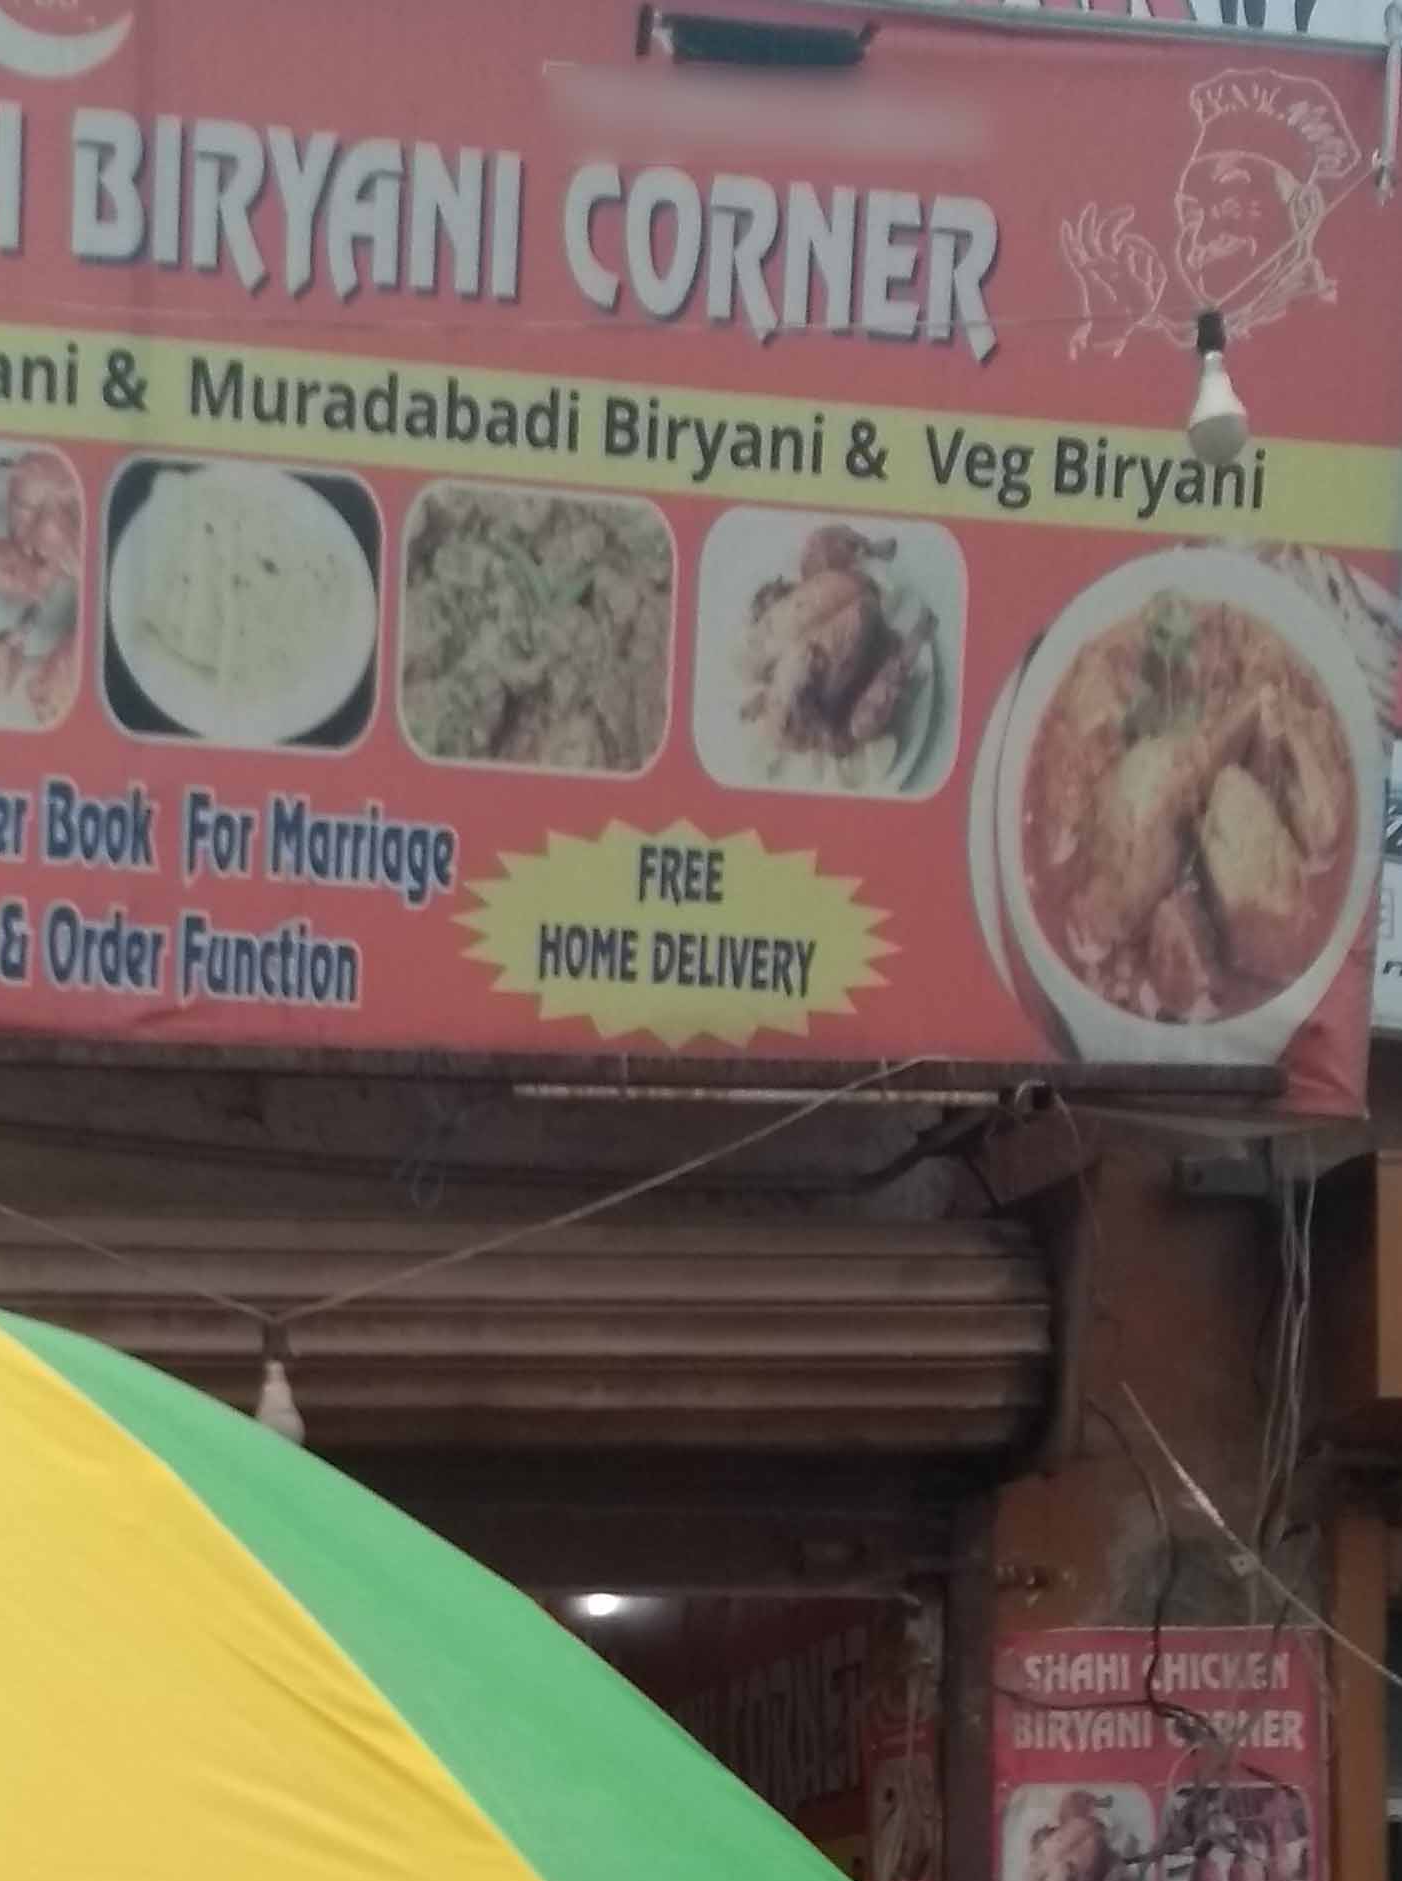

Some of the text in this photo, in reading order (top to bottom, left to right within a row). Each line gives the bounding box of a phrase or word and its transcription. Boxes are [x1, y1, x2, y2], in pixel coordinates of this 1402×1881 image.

[68, 106, 524, 303] BIRYANI
[562, 162, 1000, 366] CORNER
[101, 349, 148, 413] &
[188, 354, 582, 454] Muradabadi
[604, 396, 826, 482] Biryani
[844, 418, 889, 482] &
[926, 424, 1035, 509] Veg
[1052, 434, 1268, 520] Biryani
[42, 778, 156, 869] Book
[184, 790, 254, 884] For
[268, 796, 458, 906] Marriage
[636, 844, 725, 904] FREE
[42, 903, 167, 994] Order
[180, 912, 362, 1008] Function
[536, 921, 817, 998] HOME DELIVERY
[1022, 1652, 1131, 1694] SHAHI
[1012, 1711, 1153, 1753] BIRYANI
